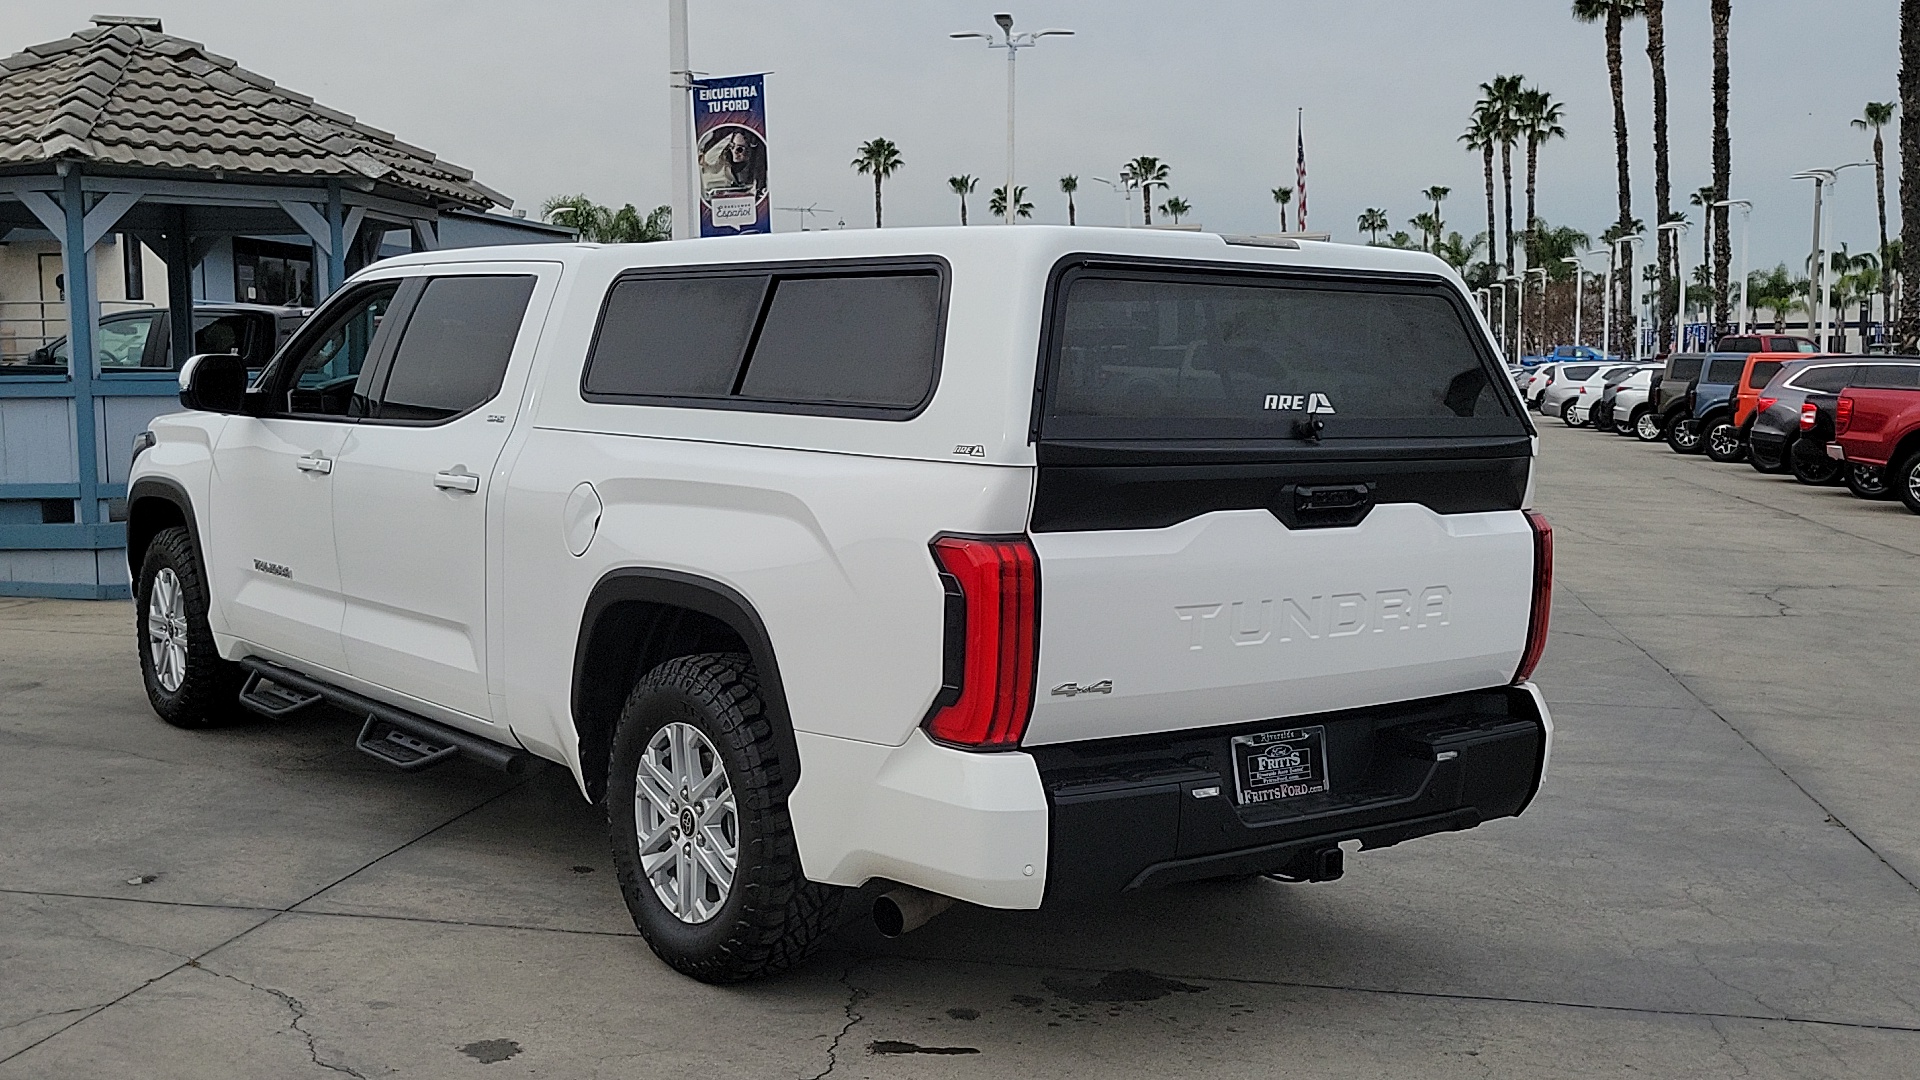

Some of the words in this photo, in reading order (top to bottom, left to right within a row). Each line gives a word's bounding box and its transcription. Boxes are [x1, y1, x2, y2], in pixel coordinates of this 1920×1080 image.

[699, 86, 758, 101] ENCUENTRA
[708, 102, 721, 113] TU
[721, 100, 750, 112] FORD
[716, 207, 751, 219] Español
[1264, 394, 1305, 410] ARE
[1174, 584, 1452, 651] TUNDRA
[1260, 730, 1295, 743] Riverside
[1257, 751, 1301, 771] FRITTS
